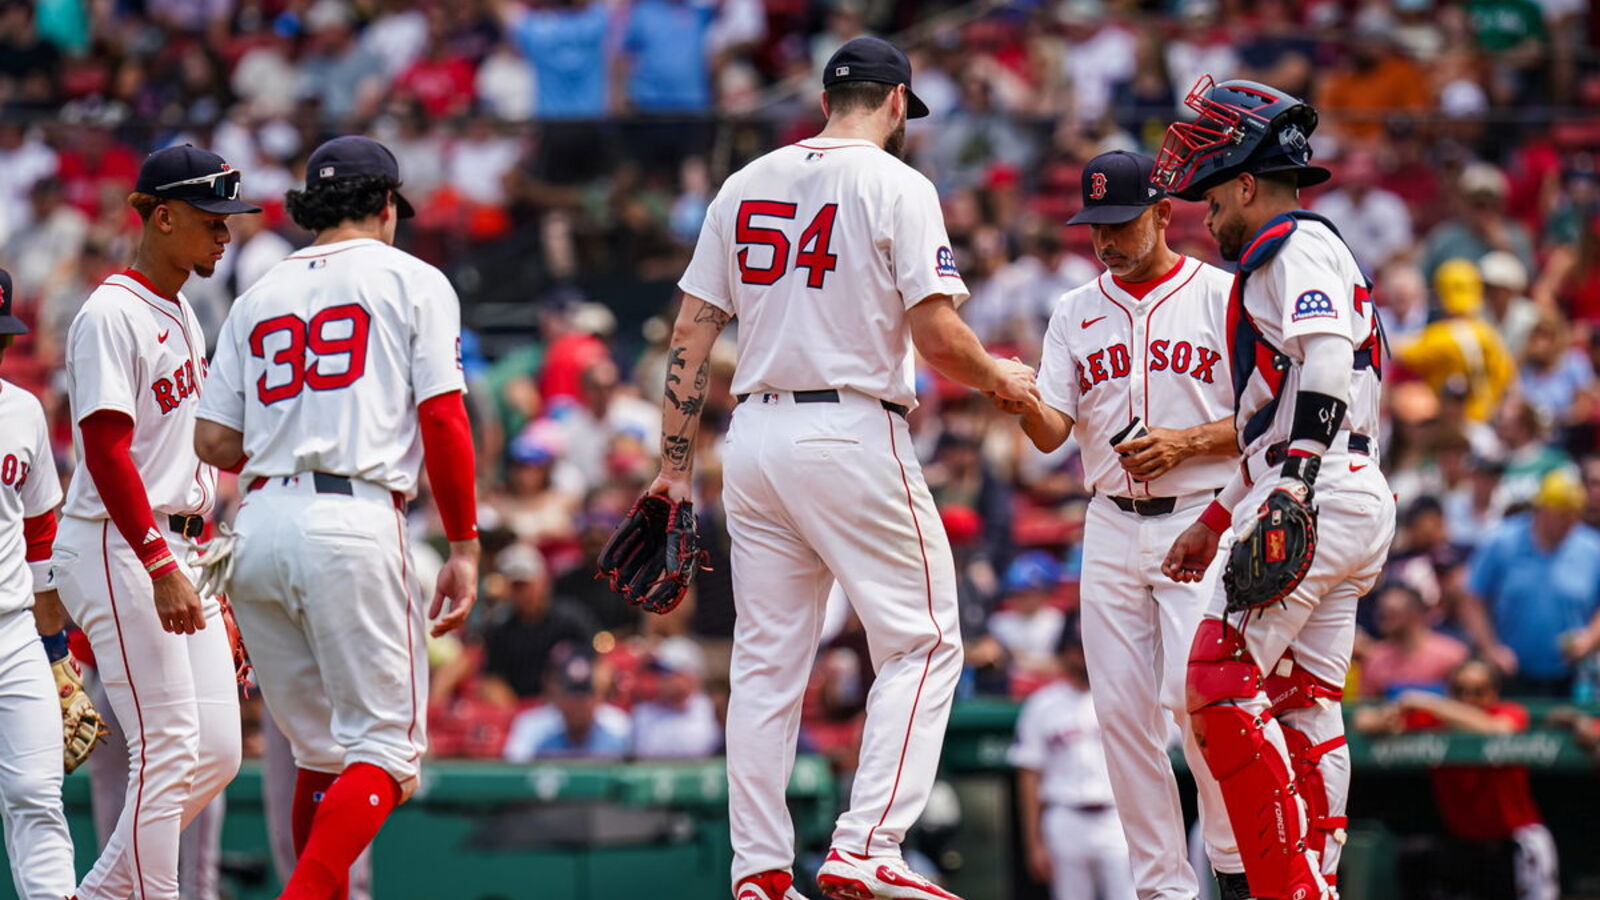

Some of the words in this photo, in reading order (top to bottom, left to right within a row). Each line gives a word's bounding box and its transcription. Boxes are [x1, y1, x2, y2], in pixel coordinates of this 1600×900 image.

[1089, 172, 1107, 200] B
[735, 200, 839, 289] 54
[248, 302, 371, 407] 39
[1149, 339, 1222, 384] SOX
